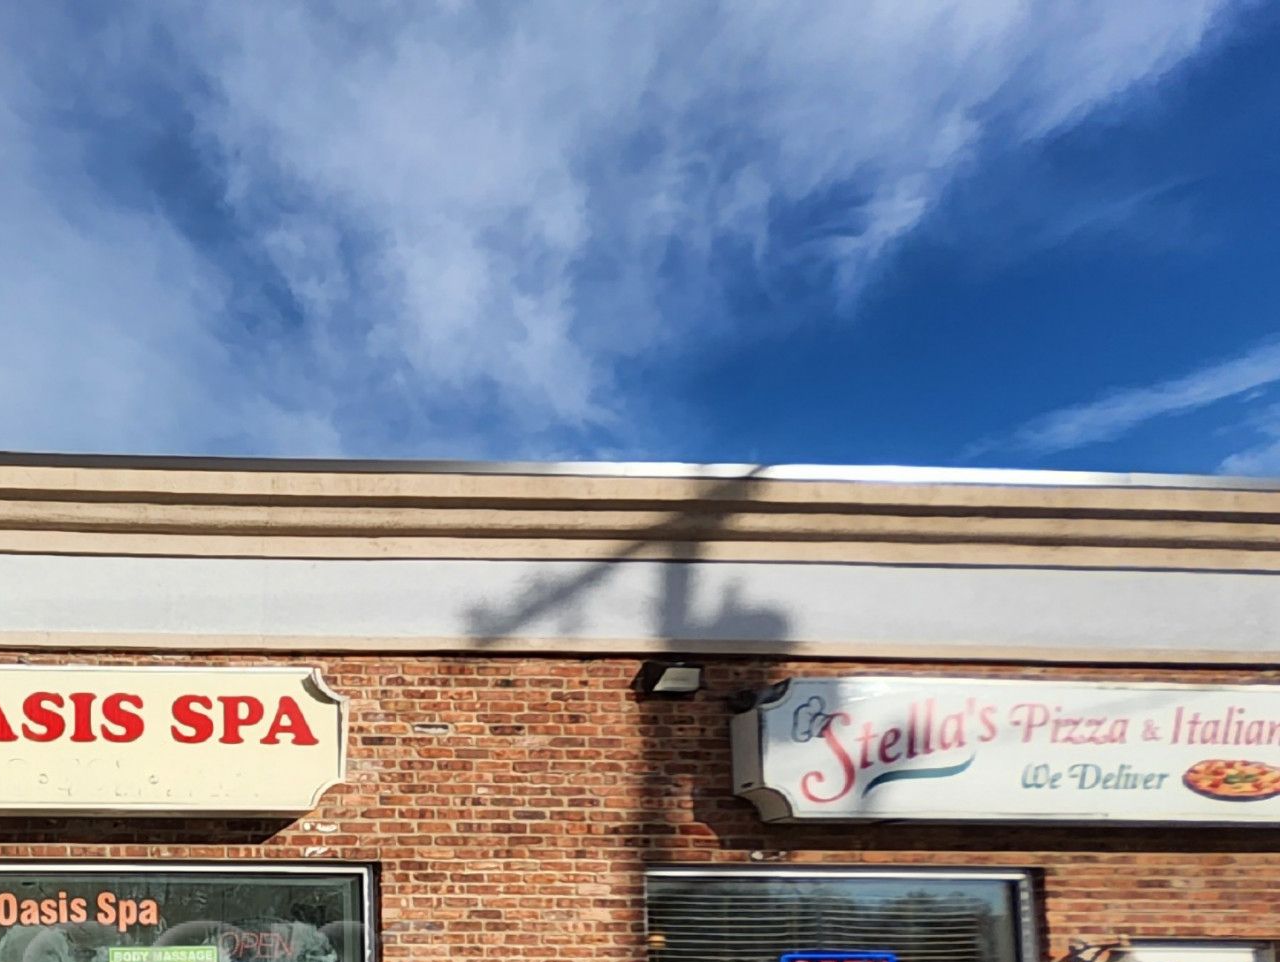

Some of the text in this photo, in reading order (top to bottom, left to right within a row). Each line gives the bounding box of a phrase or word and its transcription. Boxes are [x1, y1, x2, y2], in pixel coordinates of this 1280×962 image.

[170, 694, 319, 746] SPA
[800, 697, 998, 804] Stella's
[1009, 703, 1130, 745] Pizza
[1142, 719, 1163, 742] &
[1021, 762, 1170, 790] We Deliver
[97, 891, 159, 933] Spa
[113, 950, 213, 961] BODY MASSAGE
[221, 931, 293, 958] OPEN
